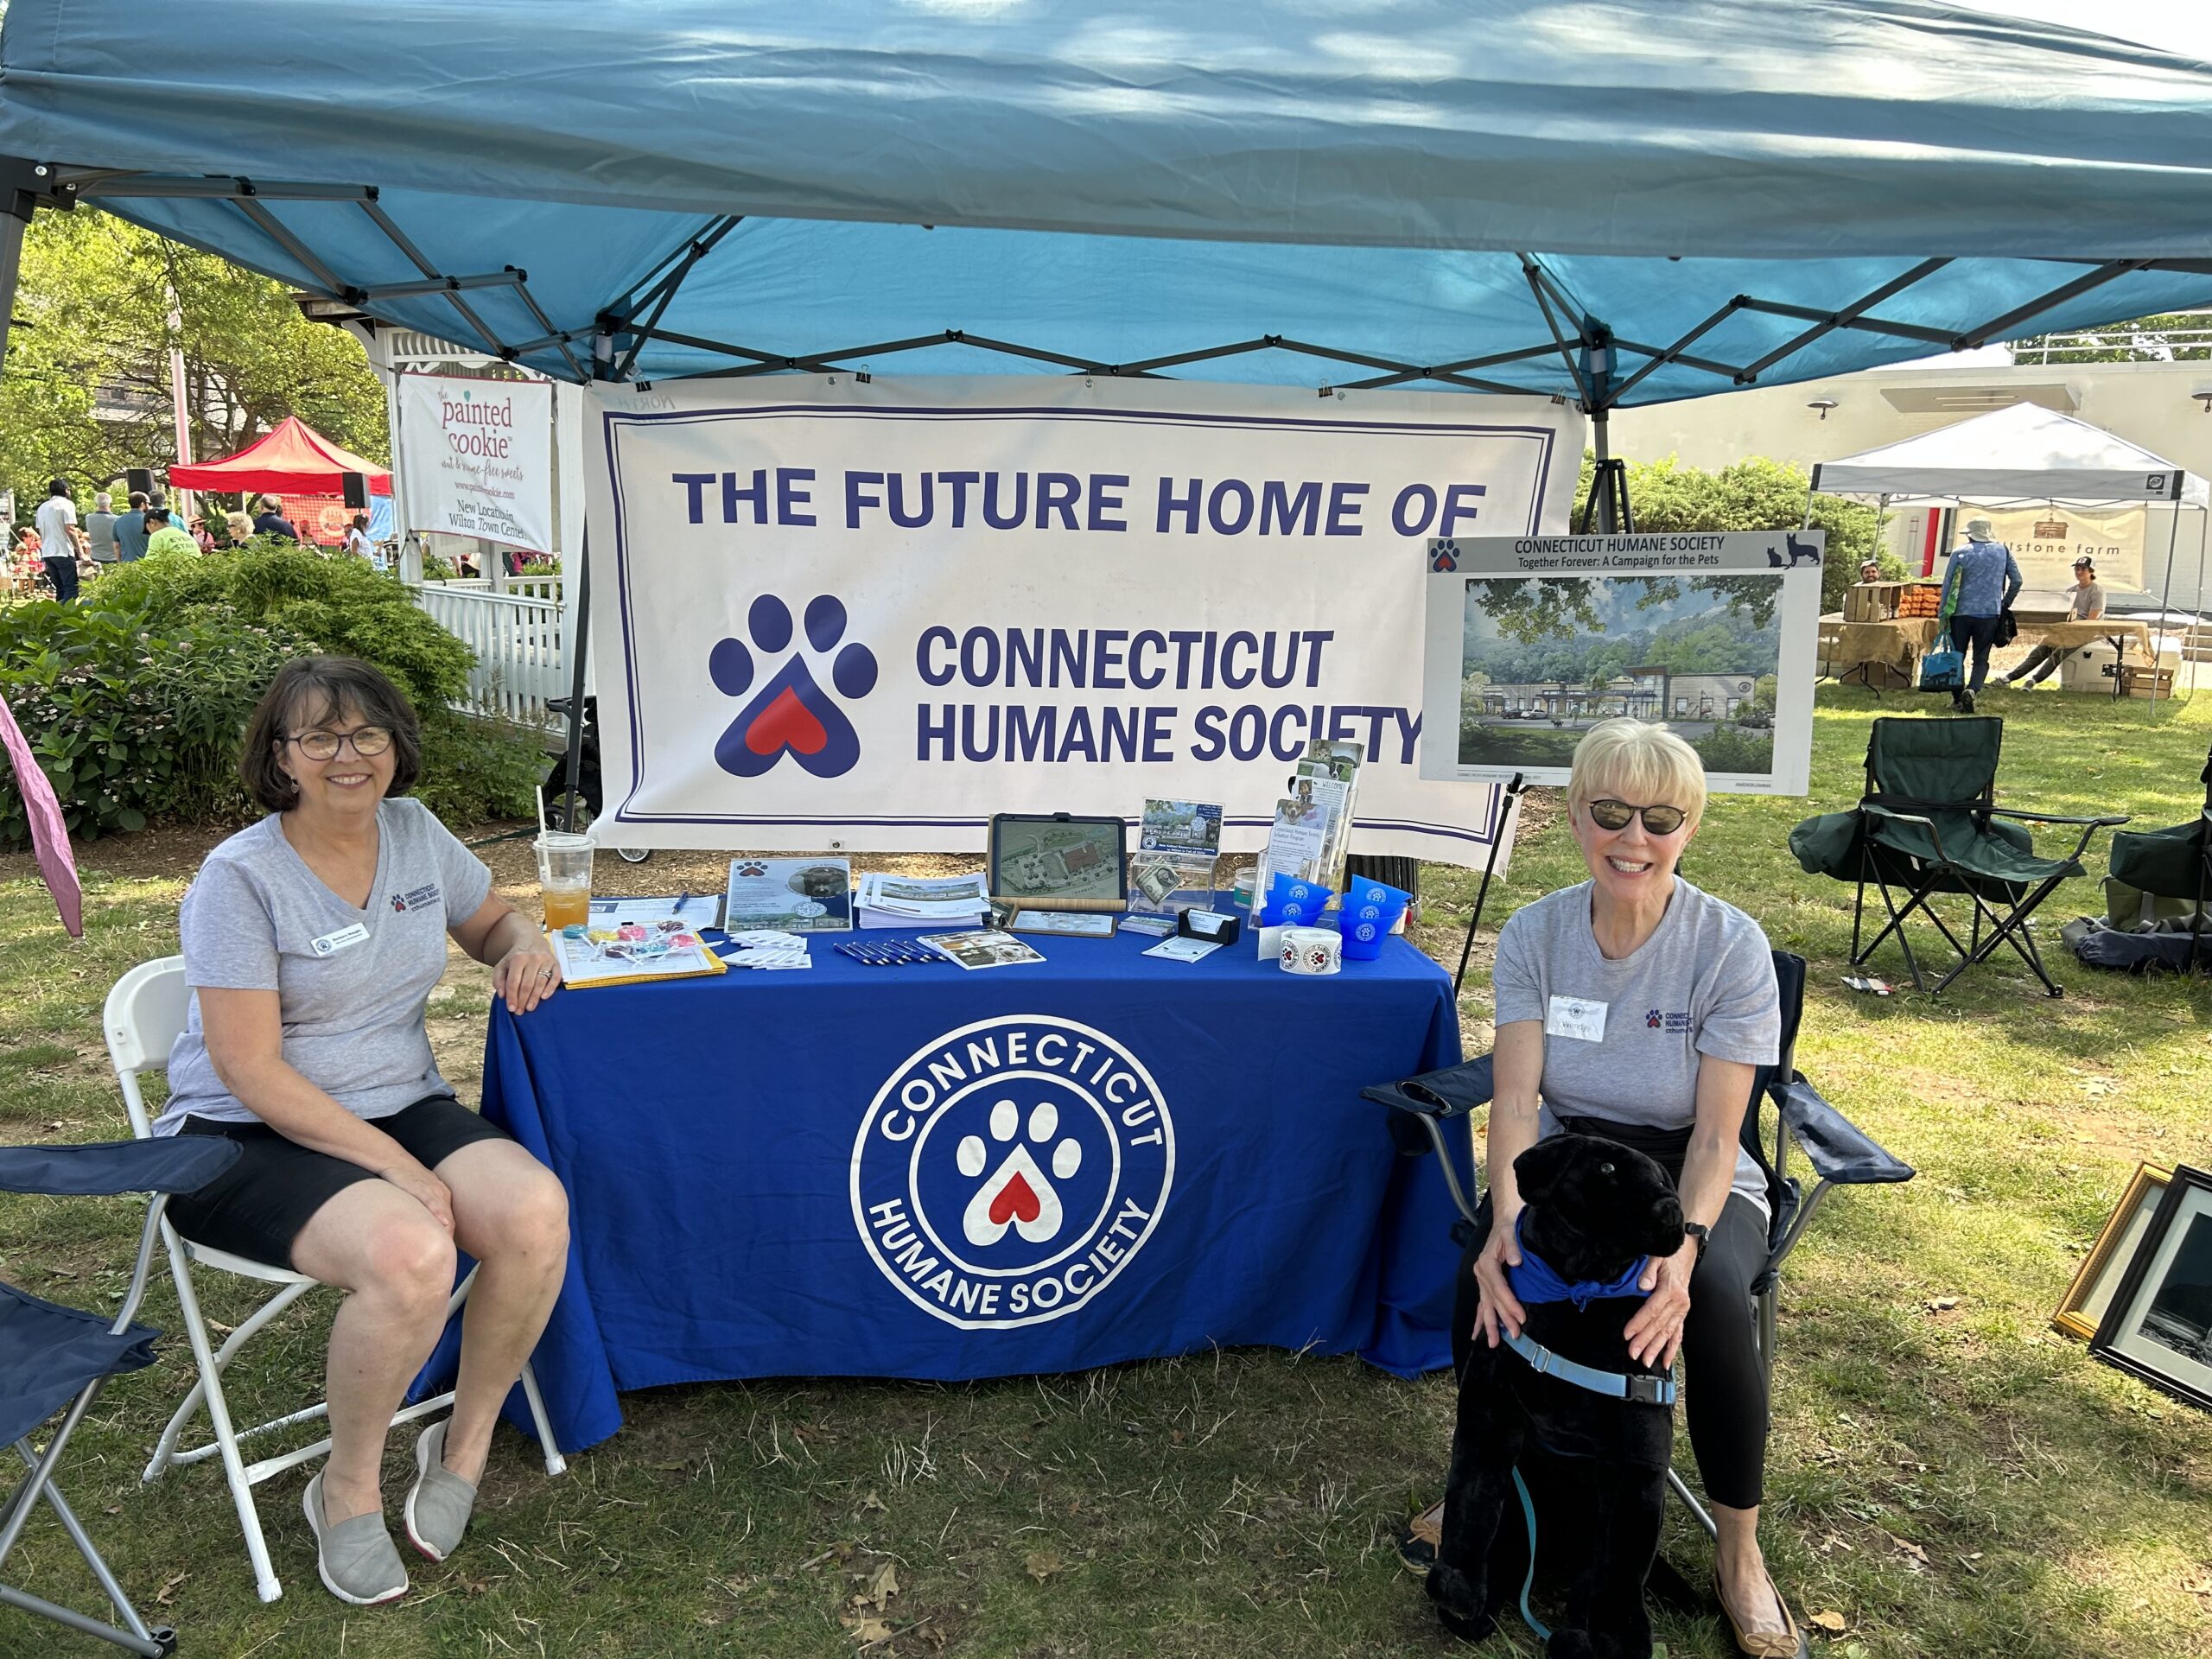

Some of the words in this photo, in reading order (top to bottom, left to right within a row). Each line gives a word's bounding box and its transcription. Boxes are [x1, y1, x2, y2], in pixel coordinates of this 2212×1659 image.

[442, 397, 512, 429] painted
[456, 499, 476, 515] New
[672, 467, 817, 527] THE
[845, 469, 1130, 532] FUTURE
[1156, 476, 1370, 537] HOME
[1391, 483, 1487, 537] OF
[448, 512, 475, 530] Wilton
[478, 518, 499, 534] Town
[1515, 538, 1605, 554] CONNECTICUT
[1607, 537, 1667, 552] HUMANE
[1669, 536, 1725, 551] SOCIETY
[2076, 543, 2120, 555] farm
[1518, 556, 1559, 569] Together
[1561, 556, 1600, 568] Forever:
[1602, 556, 1610, 566] A
[1611, 554, 1659, 568] Campaign
[1662, 554, 1676, 565] for
[1679, 554, 1695, 564] the
[1698, 554, 1719, 564] Pets
[916, 626, 1334, 690] CONNECTICUT
[917, 703, 1178, 763] HUMANE
[1190, 703, 1422, 765] SOCIETY
[880, 1032, 1163, 1147] CONNECTICUT
[868, 1198, 1002, 1315] HUMANE
[1009, 1198, 1150, 1313] SOCIETY
